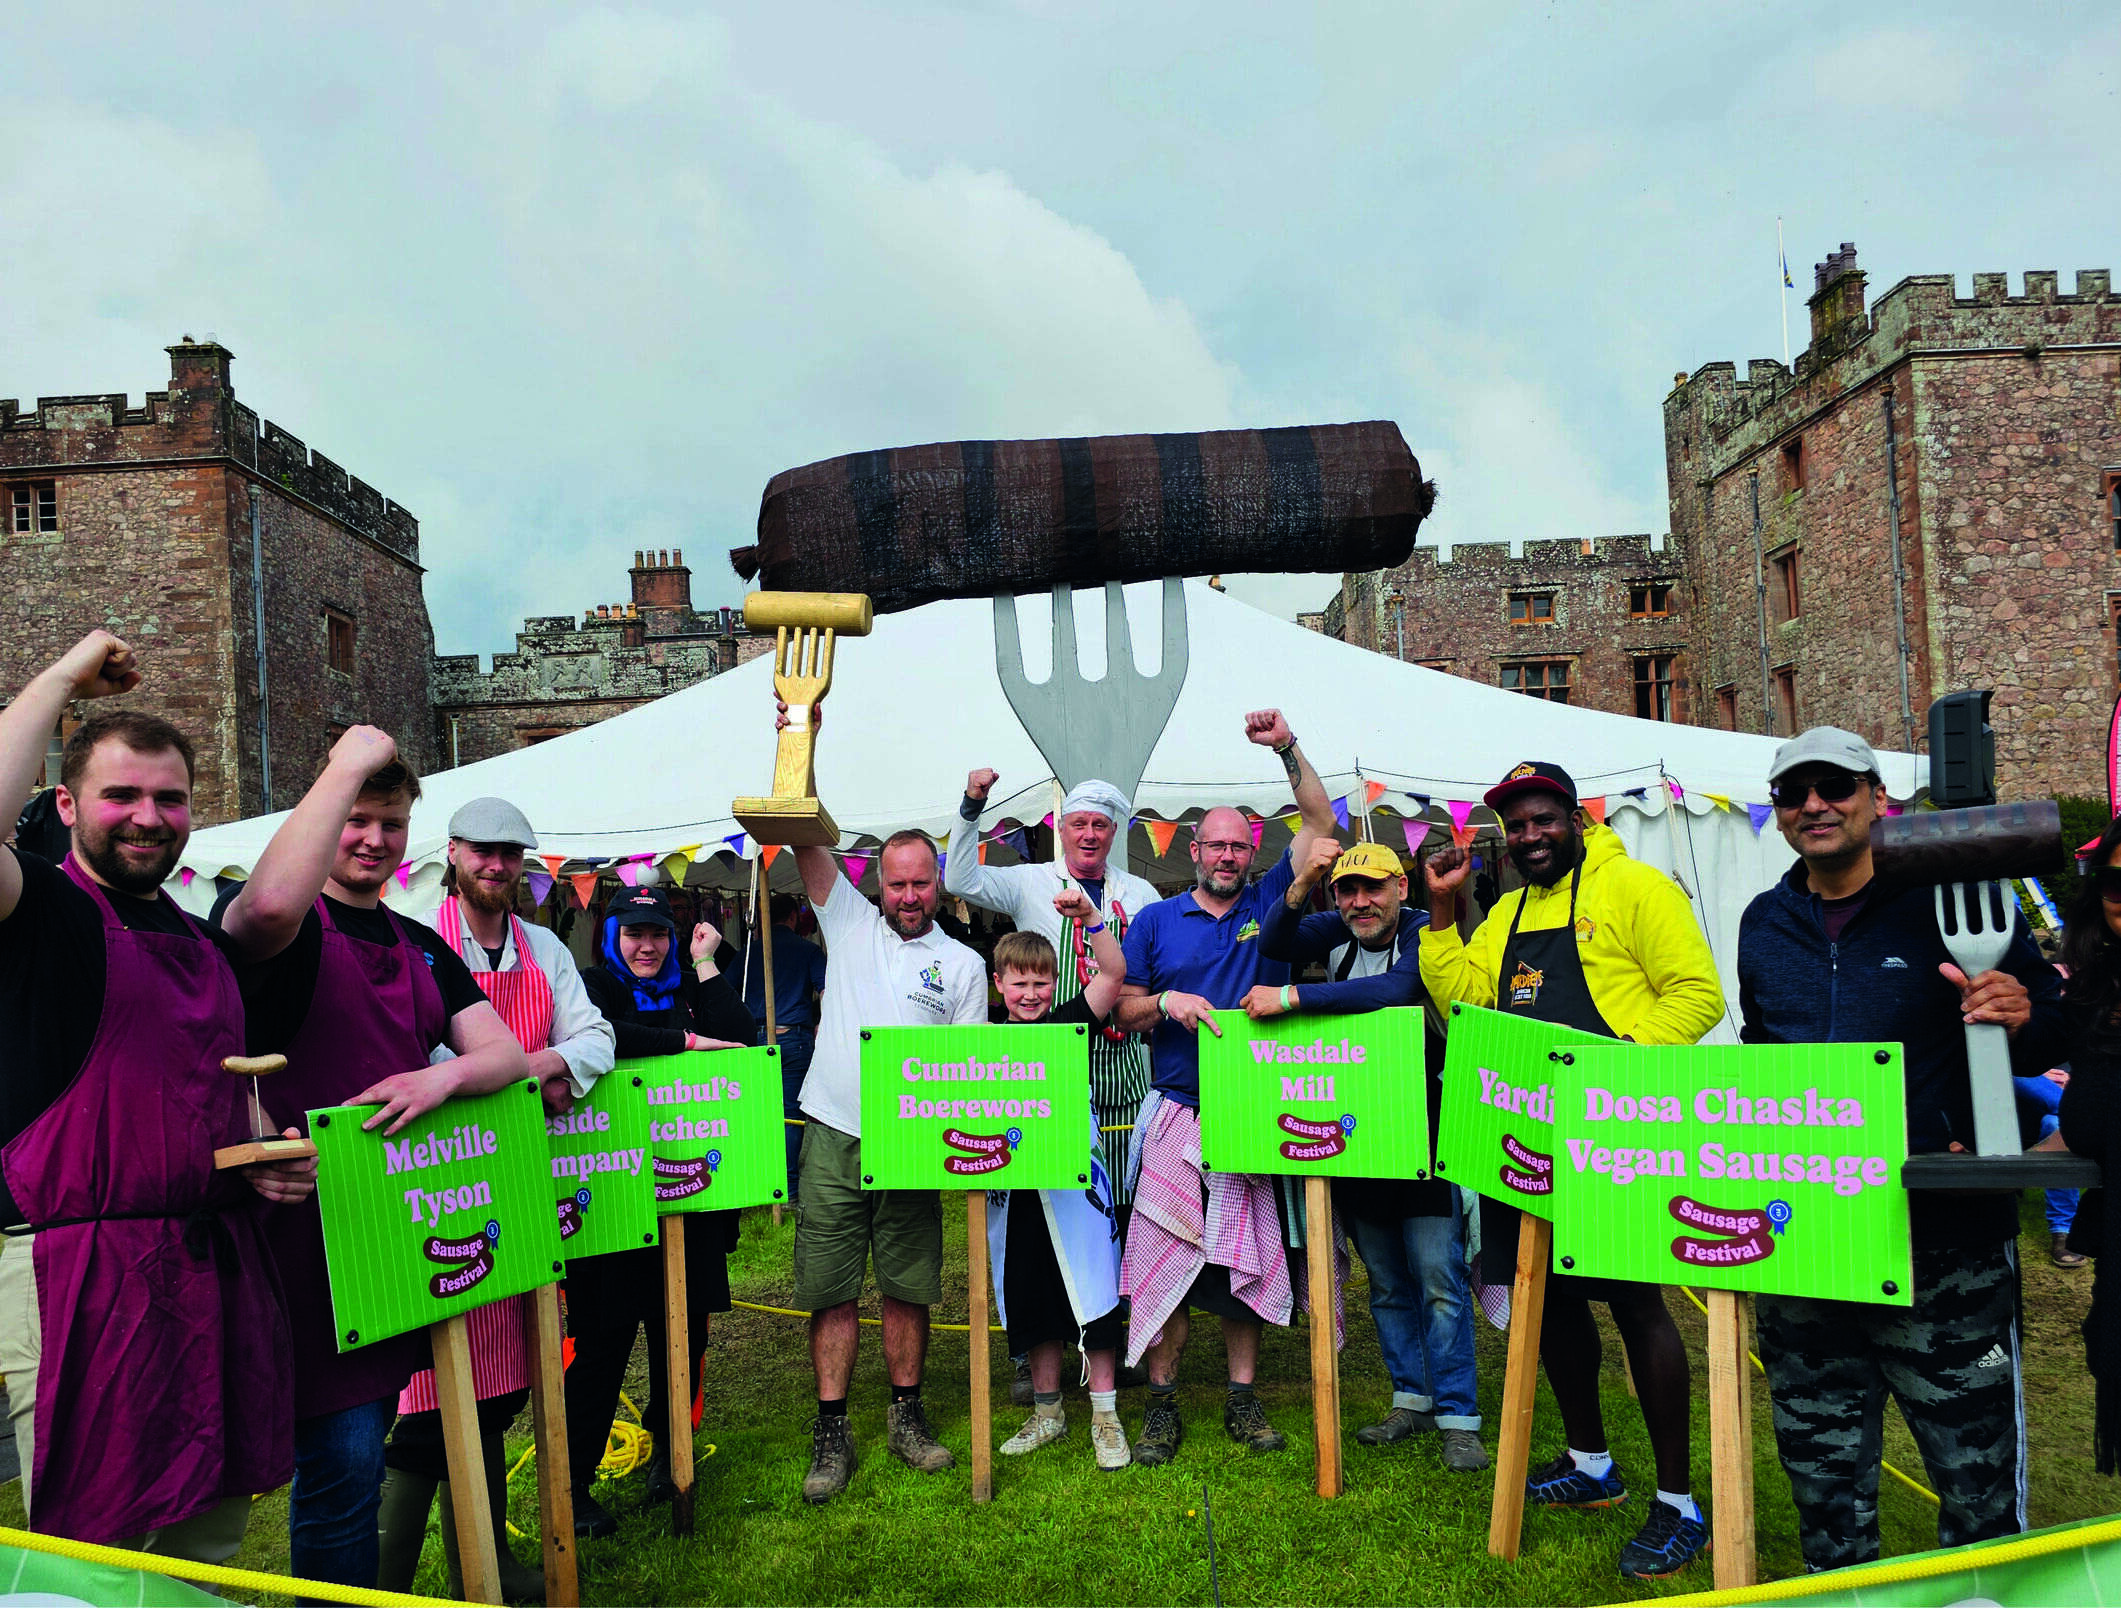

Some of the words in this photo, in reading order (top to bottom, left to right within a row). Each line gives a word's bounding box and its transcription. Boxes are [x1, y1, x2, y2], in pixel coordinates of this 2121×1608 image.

[1250, 1040, 1364, 1063] Wasdale
[903, 1056, 1045, 1080] Cumbrian
[1282, 1076, 1334, 1100] Mill
[900, 1095, 1050, 1117] Boerewors
[1586, 1089, 1682, 1122] Dosa
[1694, 1088, 1864, 1126] Chaska
[1285, 1117, 1336, 1138] Sausage
[384, 1126, 496, 1174] Melville
[950, 1132, 1002, 1151] Sausage
[1288, 1141, 1338, 1157] Festival
[654, 1159, 702, 1175] Sausage
[953, 1154, 1003, 1171] Festival
[1507, 1139, 1550, 1172] Sausage
[1567, 1140, 1687, 1184] Vegan
[1700, 1144, 1887, 1195] Sausage
[656, 1177, 704, 1197] Festival
[1507, 1171, 1549, 1190] Festival
[405, 1182, 491, 1226] Tyson
[1679, 1201, 1760, 1234] Sausage
[431, 1239, 483, 1257] Sausage
[1684, 1238, 1762, 1261] Festival
[440, 1259, 487, 1292] Festival
